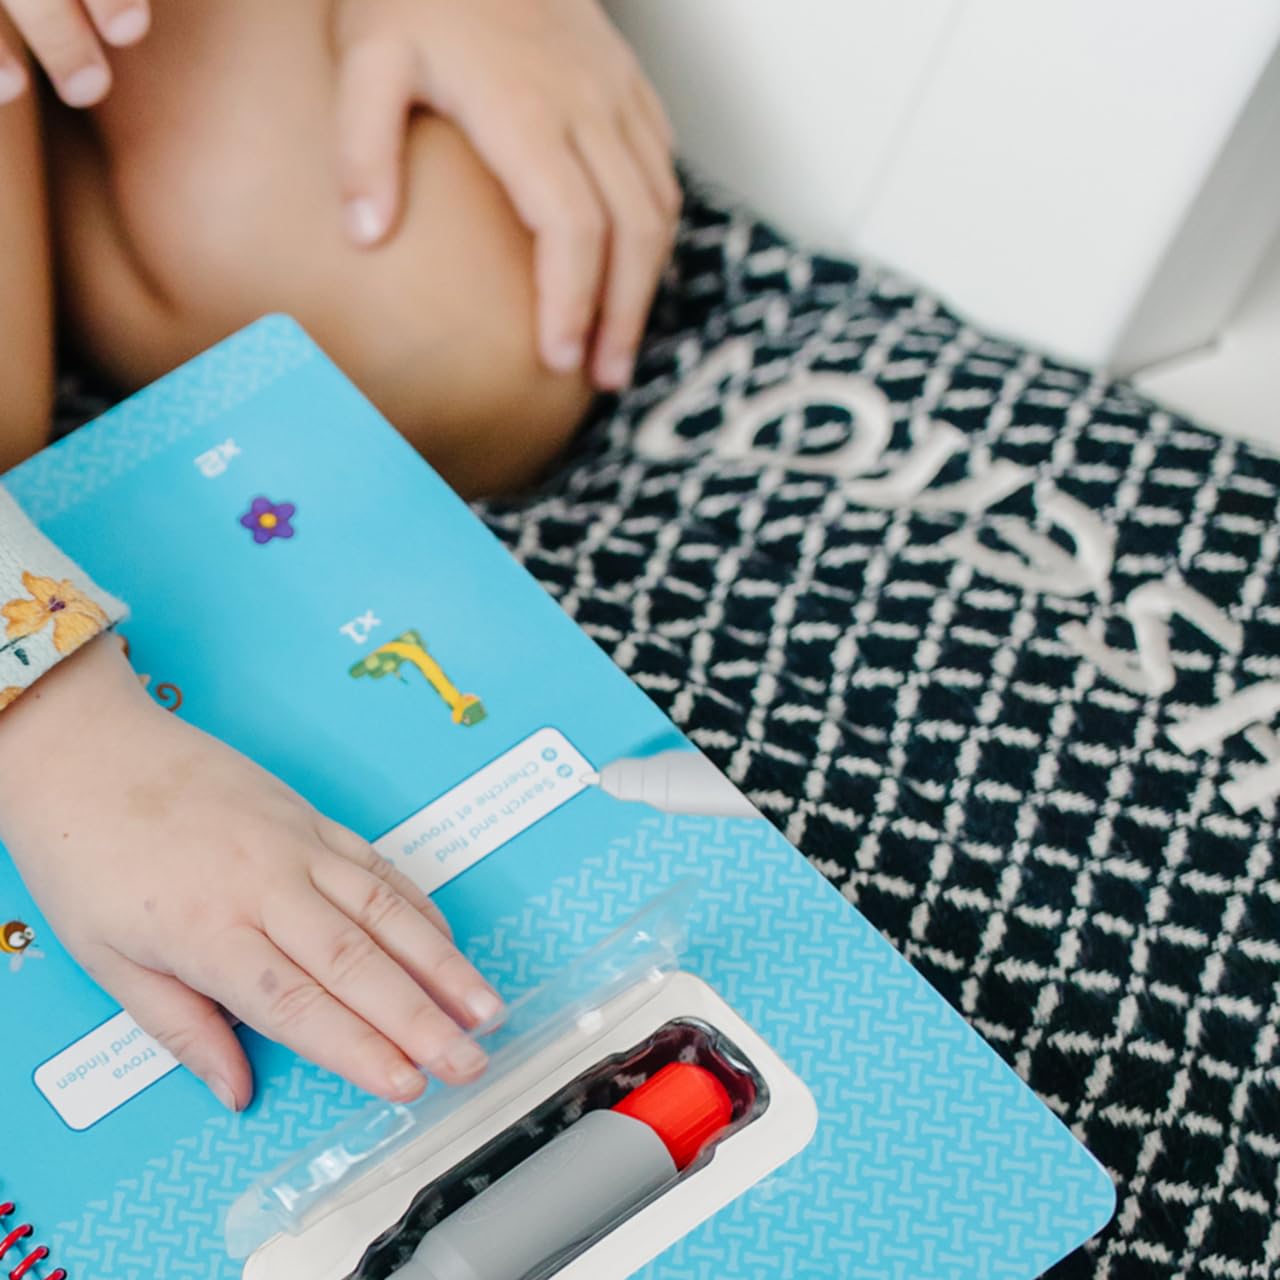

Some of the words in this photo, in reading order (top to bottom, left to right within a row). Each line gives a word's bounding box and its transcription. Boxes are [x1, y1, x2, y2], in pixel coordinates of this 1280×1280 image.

[193, 437, 241, 478] x2
[339, 609, 382, 645] x1
[475, 761, 540, 807] Cherche
[500, 777, 556, 817] Search
[456, 804, 473, 821] et
[469, 813, 499, 840] and
[403, 817, 455, 856] trouve
[435, 835, 470, 863] find
[56, 1050, 111, 1089] finden
[112, 1047, 157, 1080] trova
